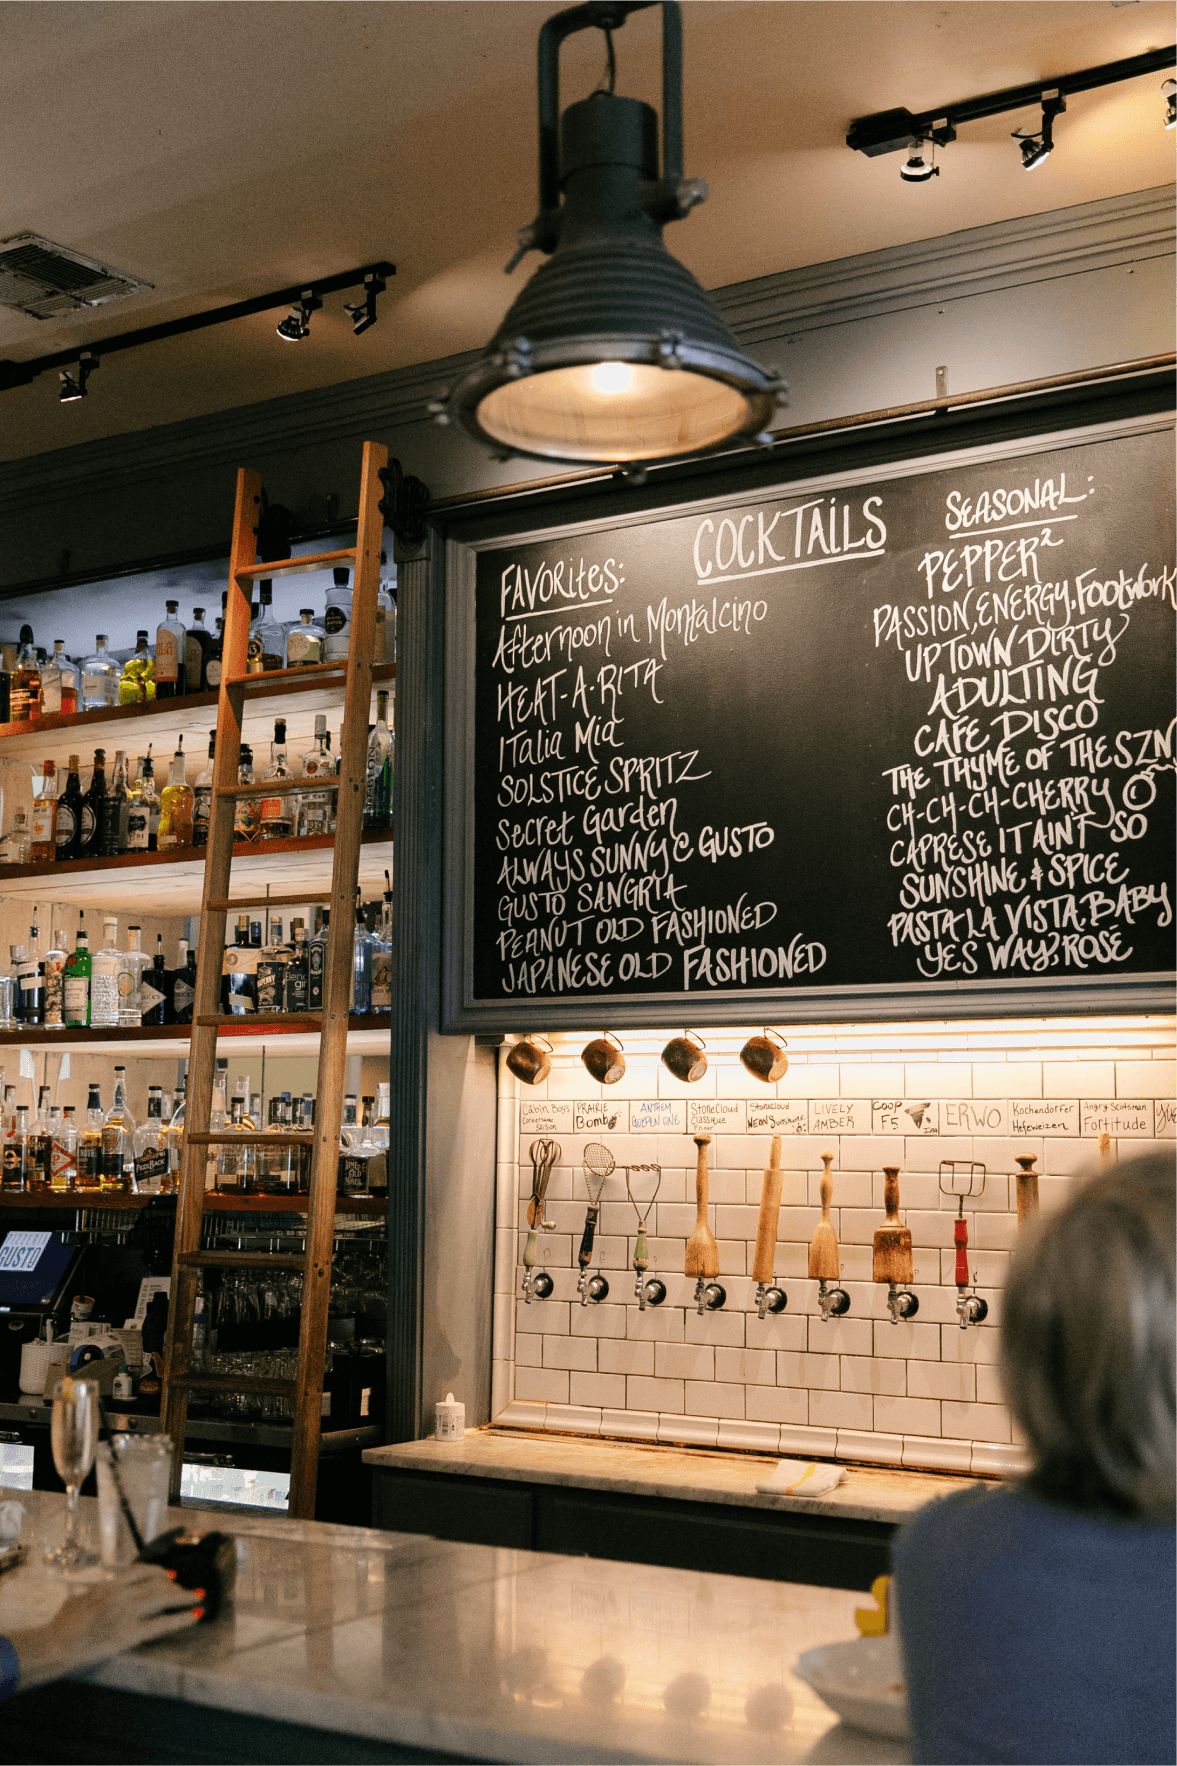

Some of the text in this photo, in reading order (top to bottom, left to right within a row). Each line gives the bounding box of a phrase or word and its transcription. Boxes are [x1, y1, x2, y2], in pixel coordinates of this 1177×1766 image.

[492, 597, 768, 674] Afternoon in Montalcino
[928, 655, 1105, 719] ADULTING
[575, 715, 624, 765] Mia
[990, 699, 1098, 740] DISCO
[498, 750, 712, 807] SOLSTICE SPRITZ
[882, 764, 931, 799] THE
[933, 748, 1021, 789] THYME
[1025, 741, 1056, 770] OF
[1060, 733, 1112, 773] THE
[496, 795, 678, 850] Secret Garden
[890, 830, 992, 873] CAPRESE
[1000, 821, 1032, 854] IT
[1110, 810, 1148, 842] SO
[496, 848, 586, 893] ALWAYS
[590, 831, 669, 879] SUNNY
[699, 822, 775, 863] GUSTO
[498, 873, 688, 927] GUSTO SANGRIA
[900, 857, 1026, 909] SUNSHINE
[1048, 852, 1130, 889] SPICE
[496, 892, 778, 962] PEANUT OLD FASHIONED
[887, 909, 965, 946] PASTA
[967, 905, 1001, 940] LA
[1079, 882, 1172, 927] BABY
[502, 933, 827, 993] JAPANESE OLD FASHIONED
[917, 941, 978, 977] YES
[522, 1103, 549, 1116] Cabin
[576, 1113, 609, 1129] Bomb
[577, 1103, 608, 1115] PRAIRIE
[640, 1102, 672, 1114] ANTHEM
[663, 1114, 680, 1126] ONE
[813, 1116, 855, 1131] AMBER
[814, 1103, 854, 1115] LIVELY
[881, 1114, 898, 1130] F5
[1012, 1120, 1069, 1135] Hefeweizen
[1084, 1101, 1108, 1112] Angry
[1084, 1115, 1147, 1132] Fortitude
